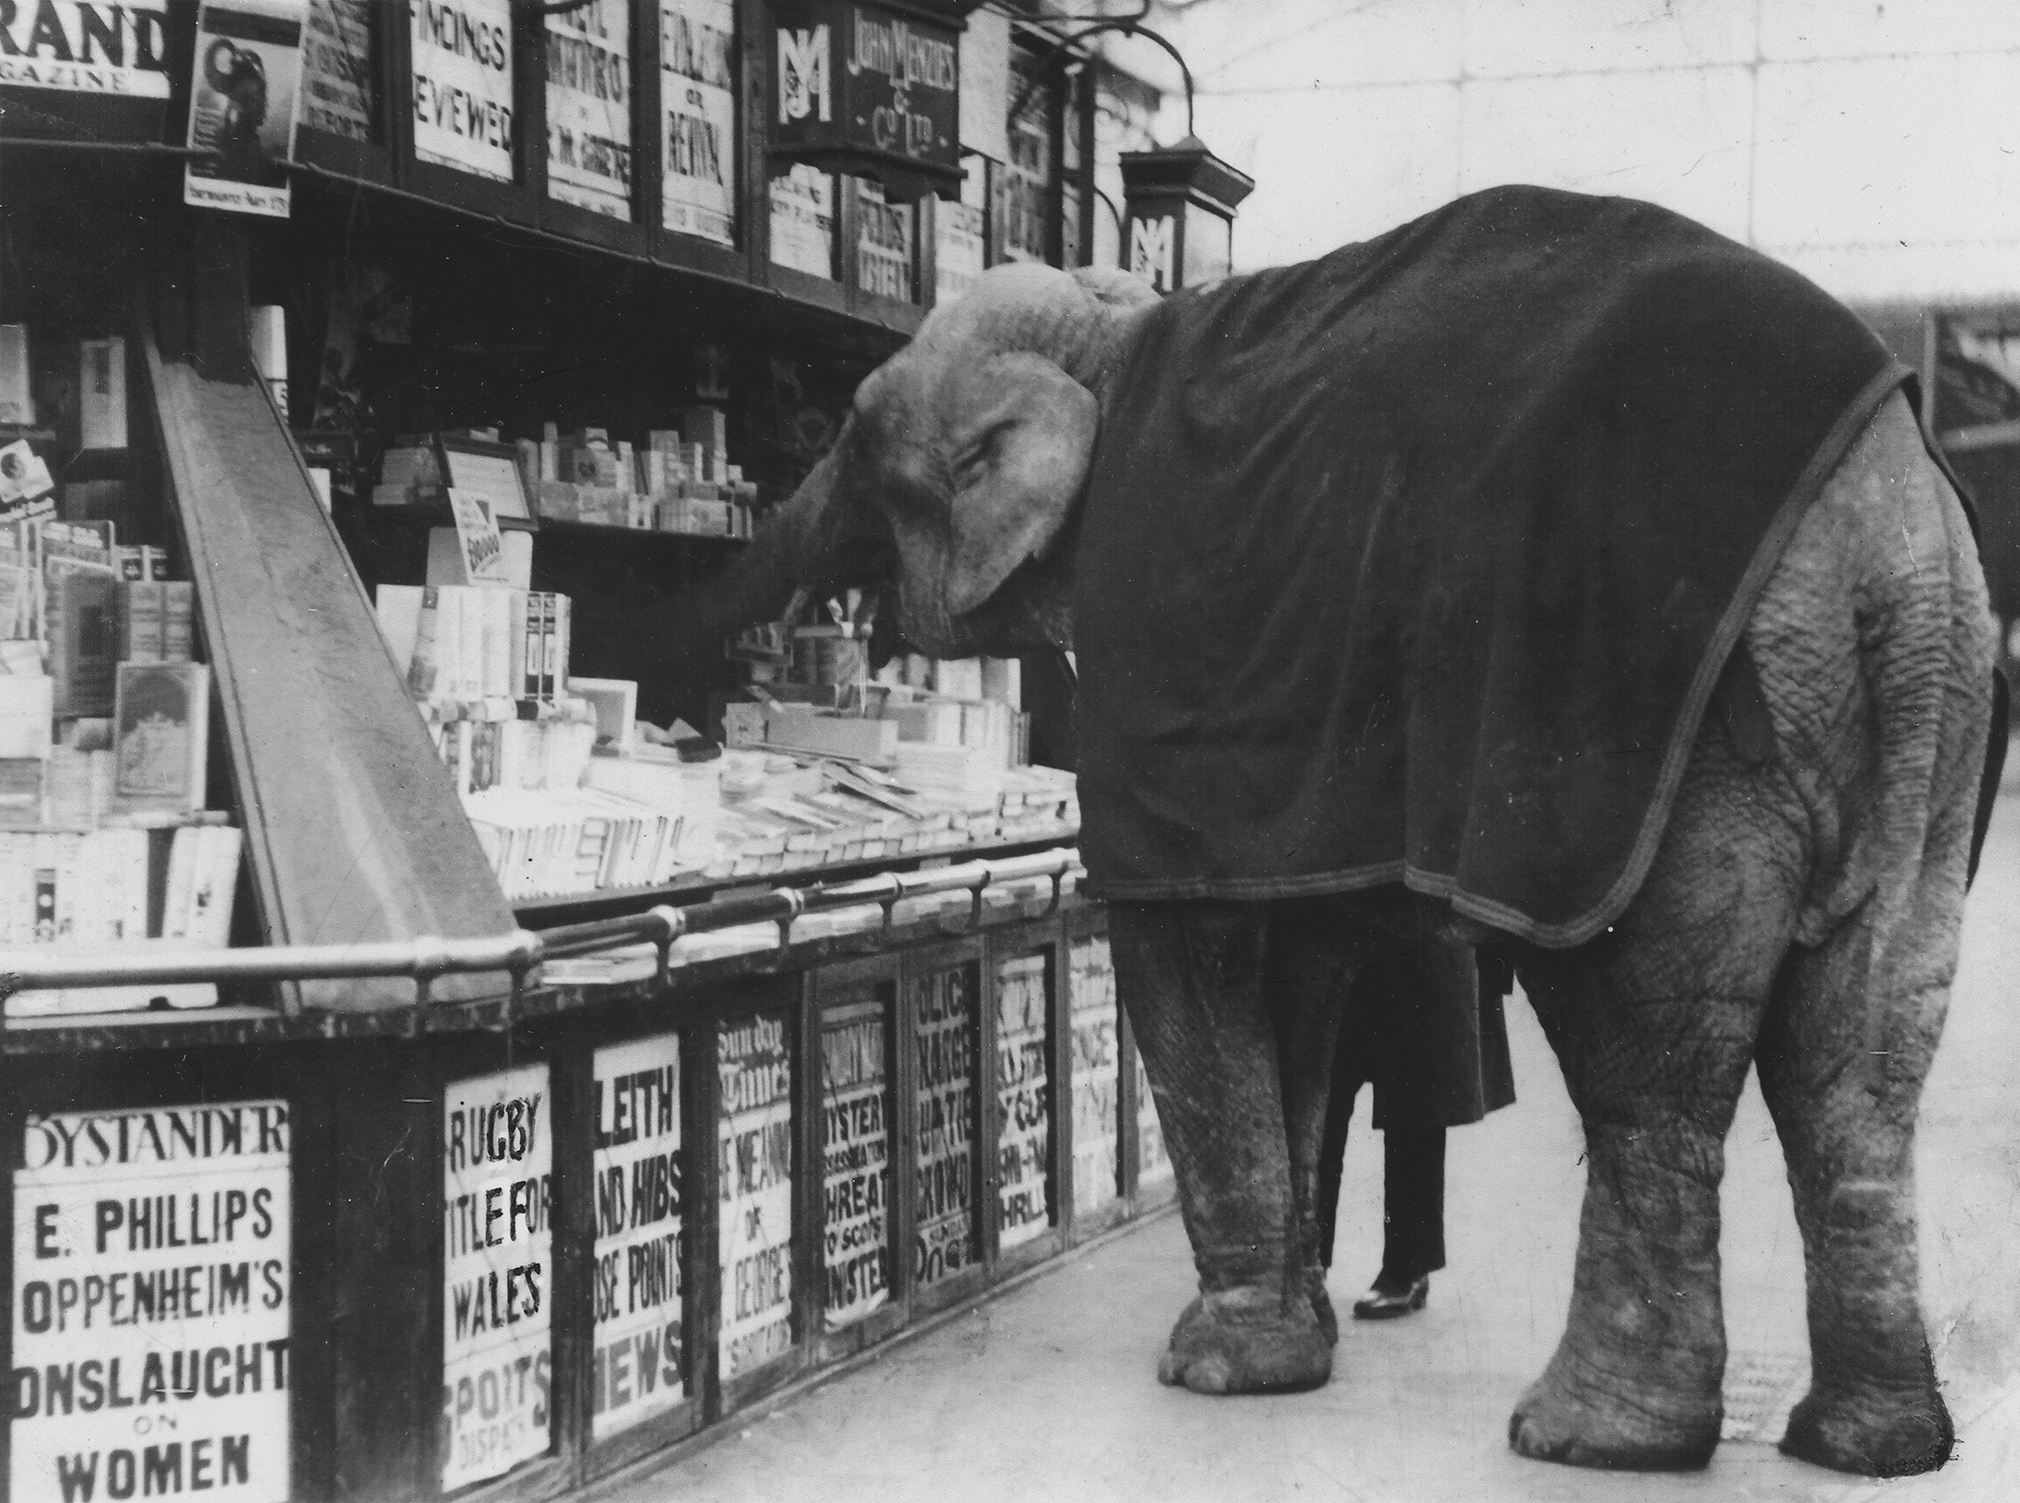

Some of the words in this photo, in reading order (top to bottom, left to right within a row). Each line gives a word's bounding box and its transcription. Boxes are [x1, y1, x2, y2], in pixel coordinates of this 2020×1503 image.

[450, 1092, 542, 1173] RUGBY
[35, 1204, 71, 1260] E.
[95, 1187, 273, 1254] PHILLIPS
[509, 1174, 552, 1242] FOR
[631, 1150, 681, 1229] HIBS
[22, 1259, 284, 1335] OPPENHEIM'S
[452, 1262, 541, 1342] WALES
[10, 1337, 290, 1420] ONSLAUGHT
[132, 1413, 178, 1436] ON
[57, 1434, 250, 1503] WOMEN
